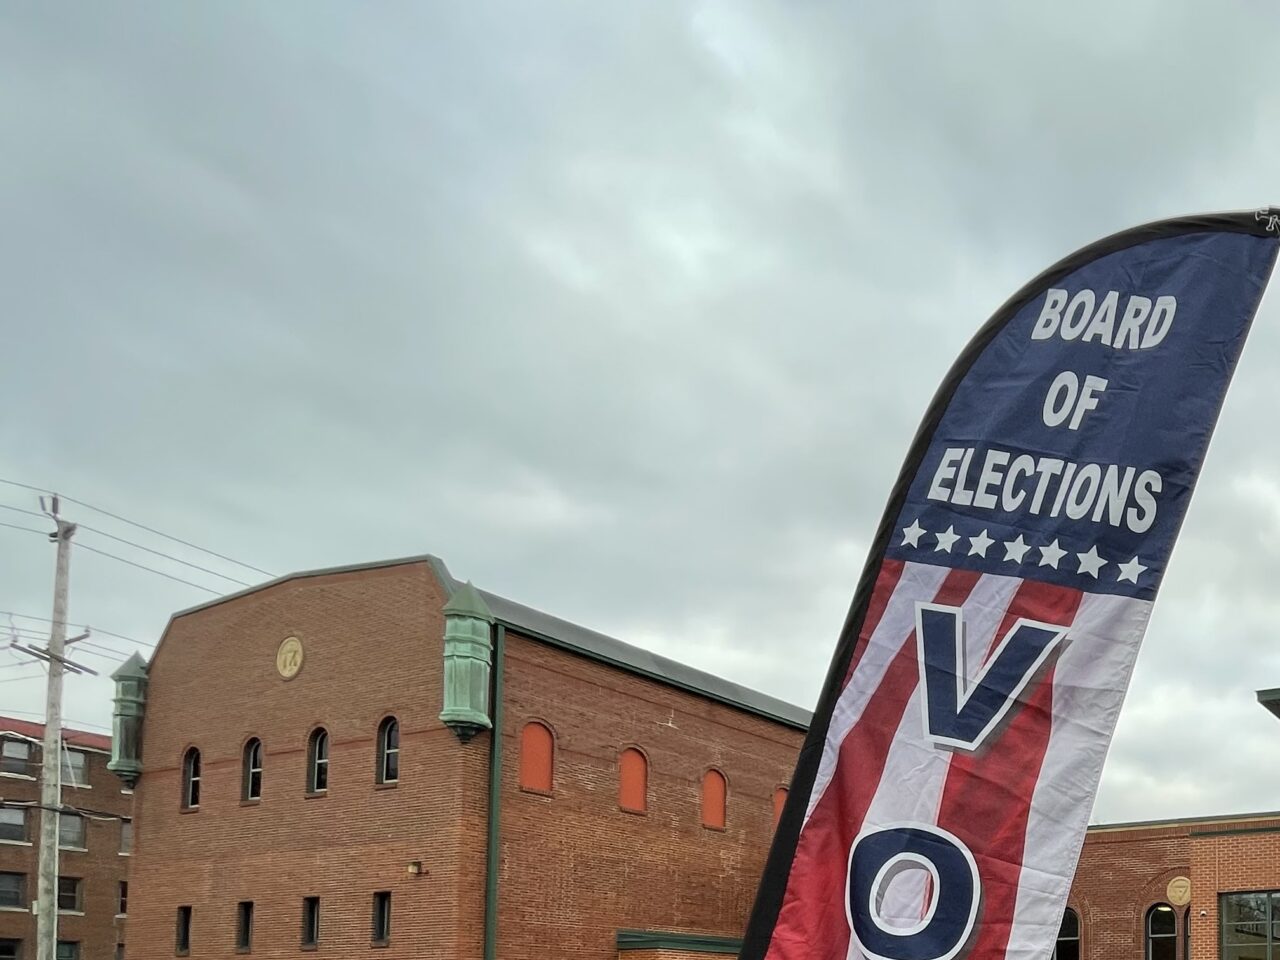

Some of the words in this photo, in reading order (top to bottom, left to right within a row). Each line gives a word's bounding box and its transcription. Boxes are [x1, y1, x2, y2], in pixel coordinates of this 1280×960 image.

[1031, 288, 1177, 350] BOARD
[1042, 370, 1108, 431] OF
[927, 447, 1162, 534] ELECTIONS
